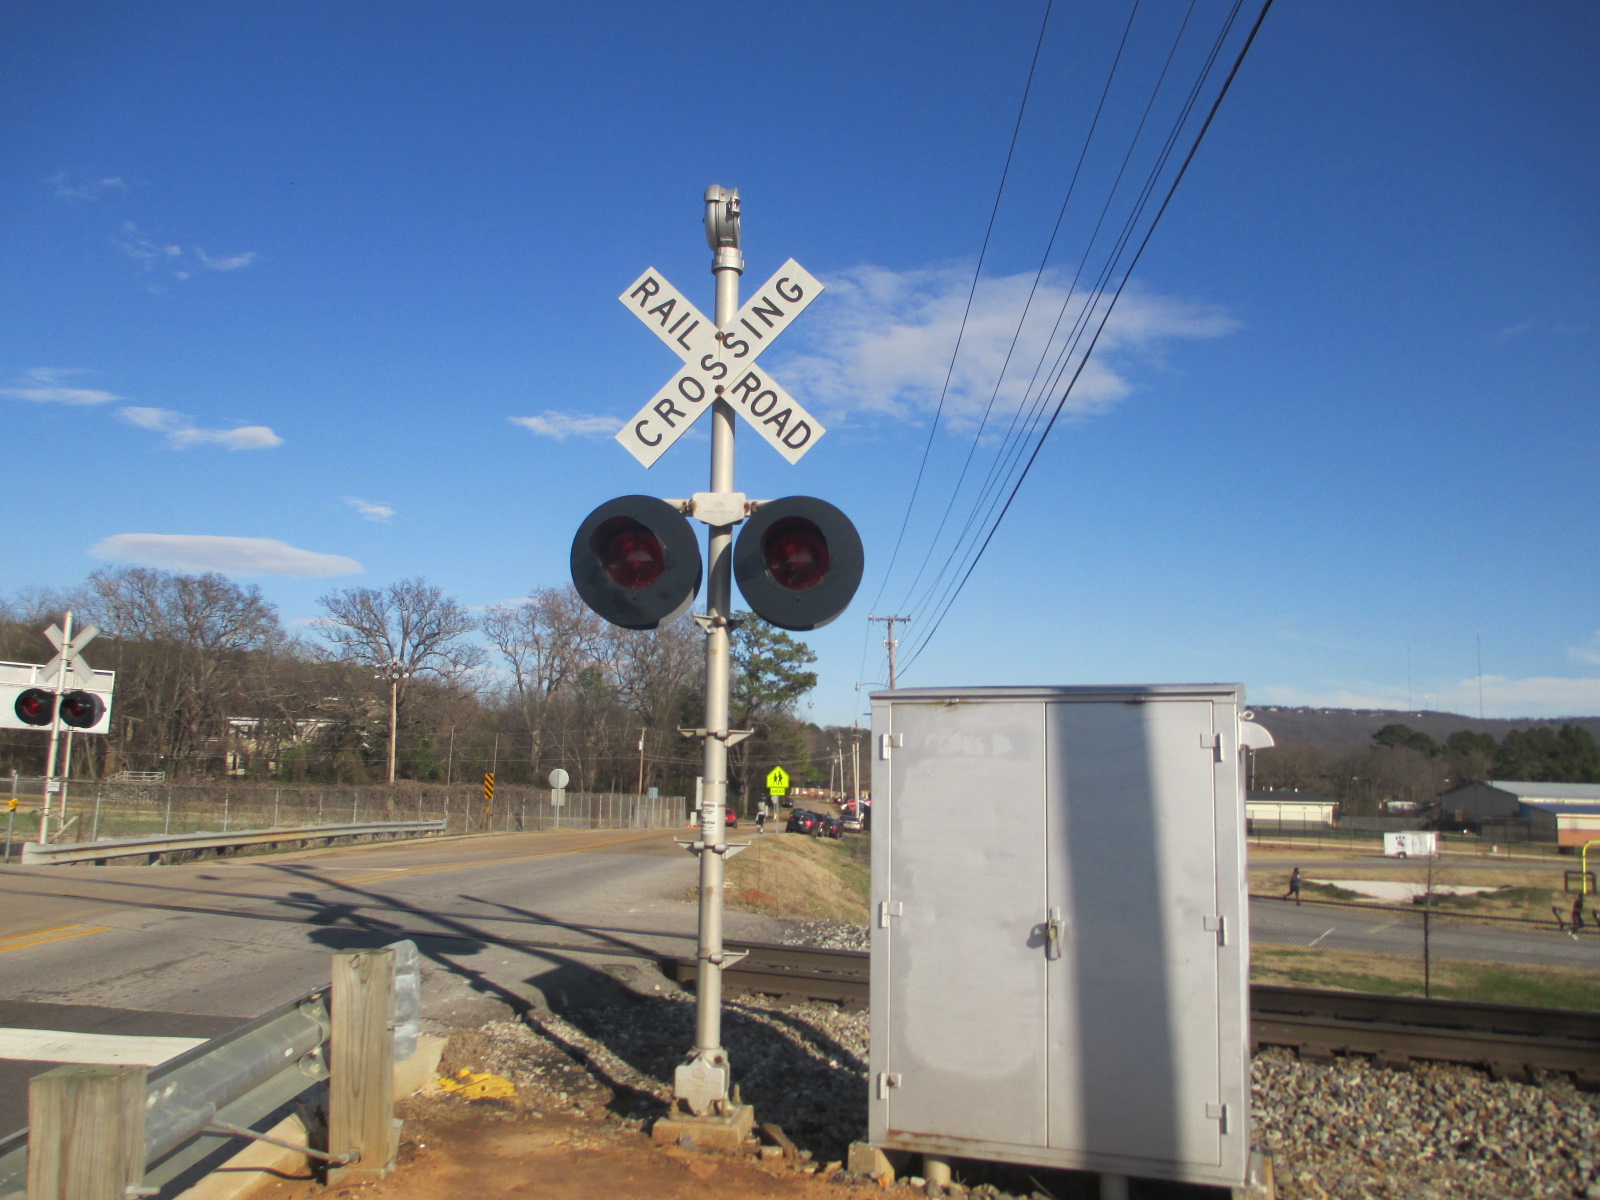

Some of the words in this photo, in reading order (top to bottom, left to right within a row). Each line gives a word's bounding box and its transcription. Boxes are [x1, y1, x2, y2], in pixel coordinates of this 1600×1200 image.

[630, 276, 700, 352] RAIL
[731, 371, 812, 450] ROAD
[635, 277, 804, 447] CROSSING
